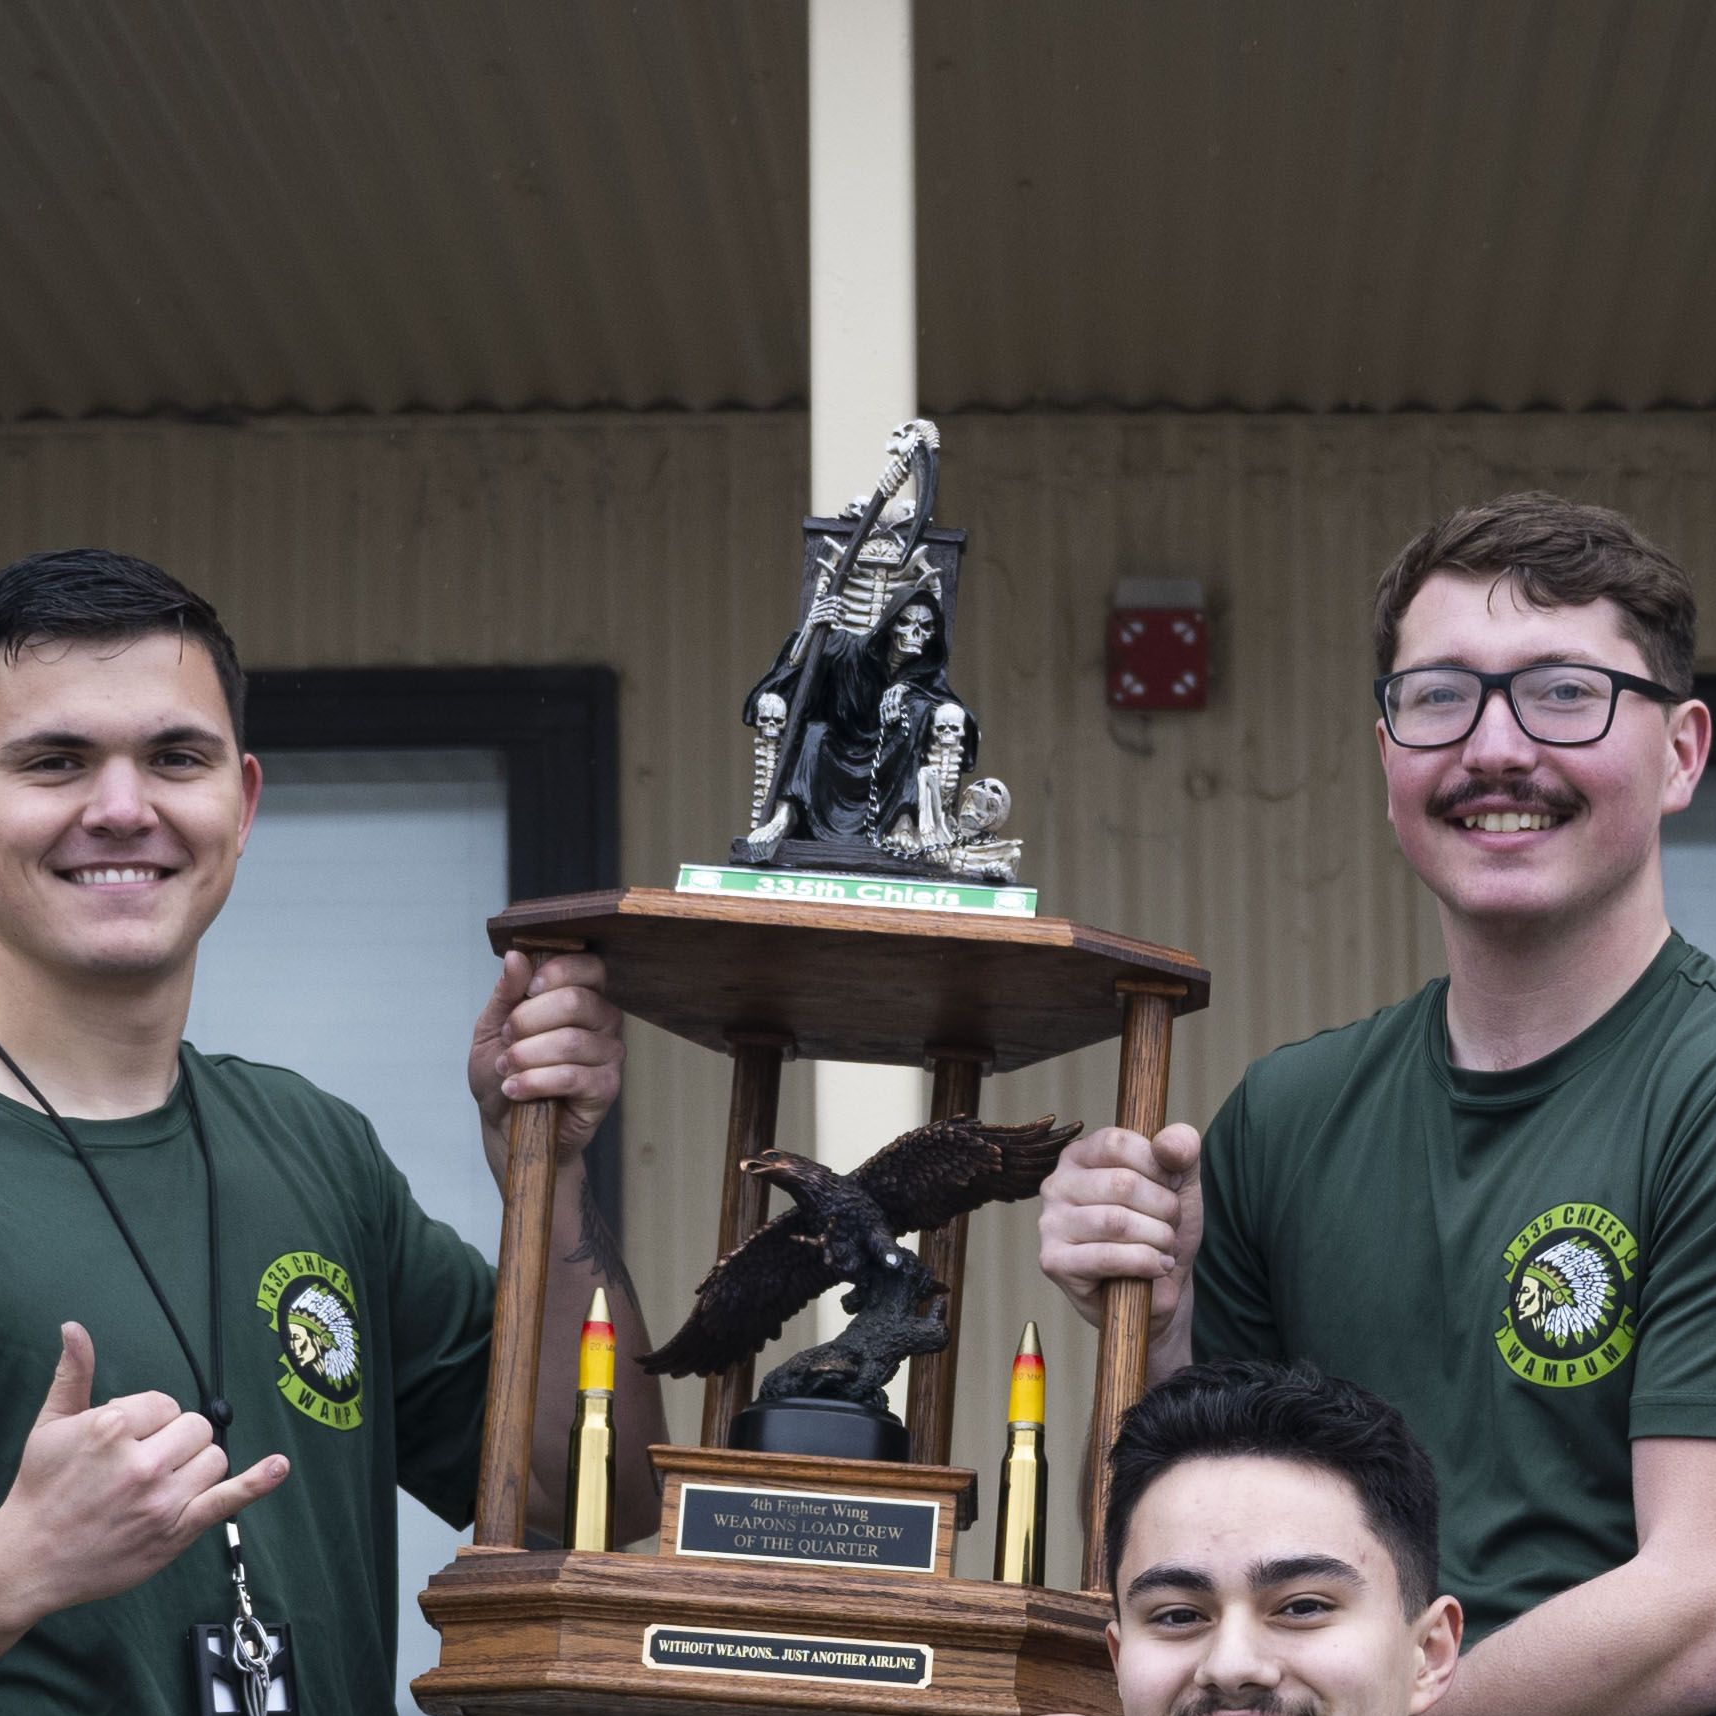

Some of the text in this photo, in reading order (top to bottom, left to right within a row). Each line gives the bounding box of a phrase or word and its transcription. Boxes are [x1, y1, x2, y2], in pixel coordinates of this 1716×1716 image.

[755, 876, 961, 907] 335th Chiefs
[1518, 1205, 1627, 1250] 335 CHIEFS
[262, 1253, 350, 1299] 335 CHIEFS
[1506, 1341, 1622, 1383] WAMPUM
[750, 1497, 869, 1521] 4th Fighter Wing
[713, 1513, 904, 1540] WEAPONS LOAD CREW
[734, 1534, 879, 1558] OF THE QUARTER
[658, 1638, 715, 1656] WITHOUT
[781, 1648, 810, 1663] JUST
[810, 1649, 867, 1667] ANOTHER
[868, 1654, 917, 1671] AIRLINE
